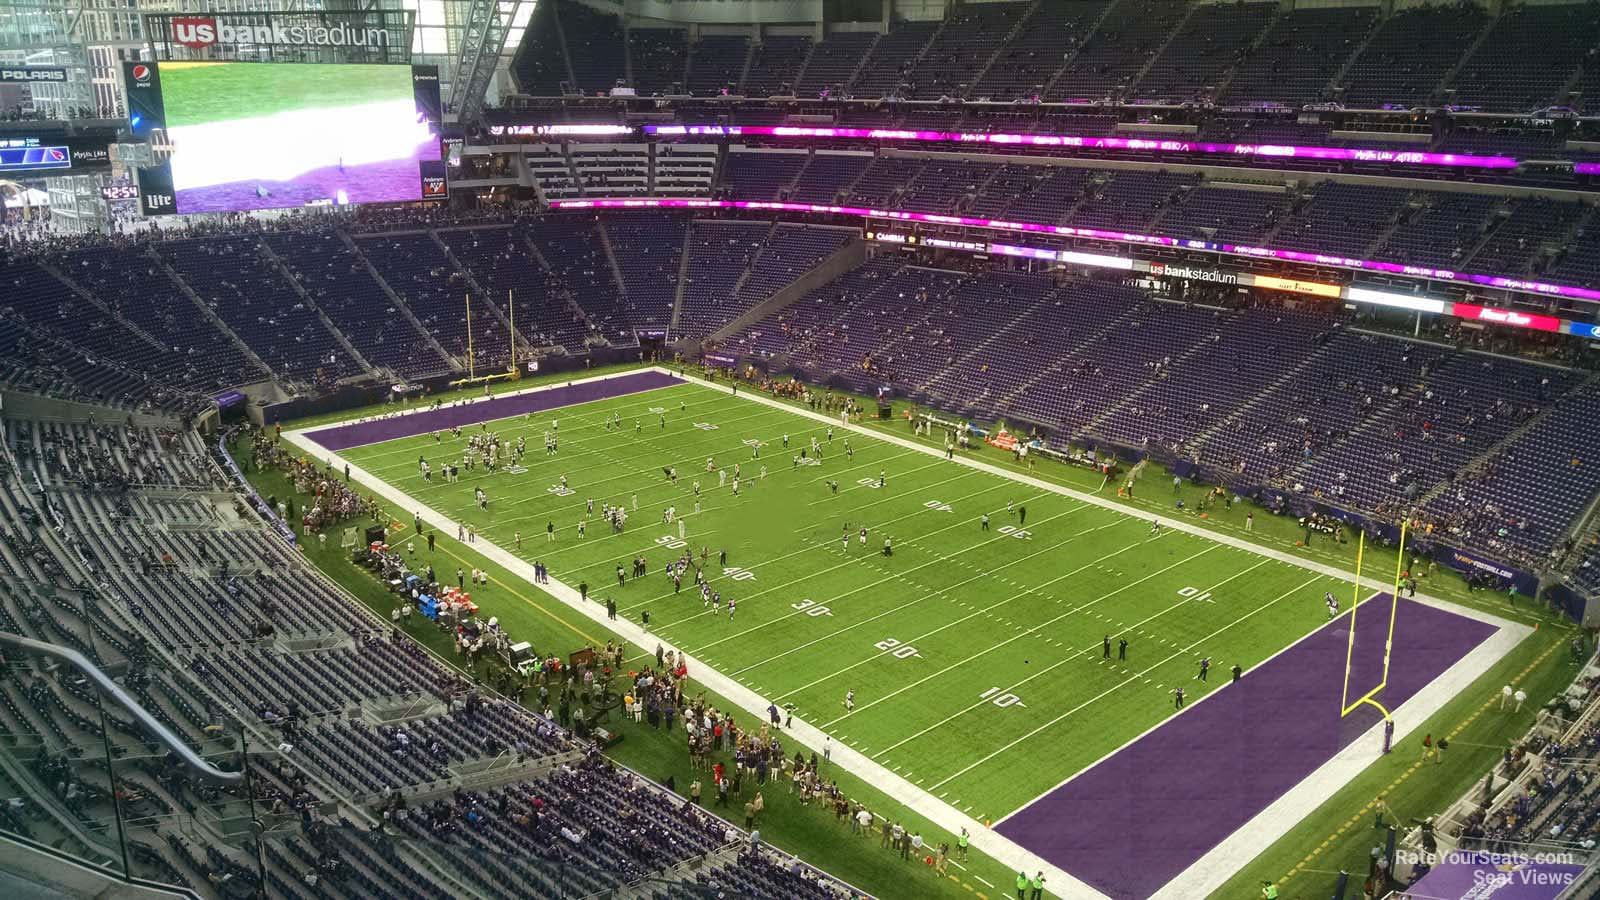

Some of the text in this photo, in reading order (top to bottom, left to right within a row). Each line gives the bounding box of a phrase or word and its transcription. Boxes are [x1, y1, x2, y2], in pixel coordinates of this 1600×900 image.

[1, 70, 64, 80] POLARIS
[102, 187, 138, 198] 42:54
[147, 195, 171, 208] Lite
[654, 535, 689, 550] 50
[722, 567, 754, 581] 40
[791, 598, 830, 617] 30
[873, 638, 919, 660] 20
[978, 686, 1021, 708] 10
